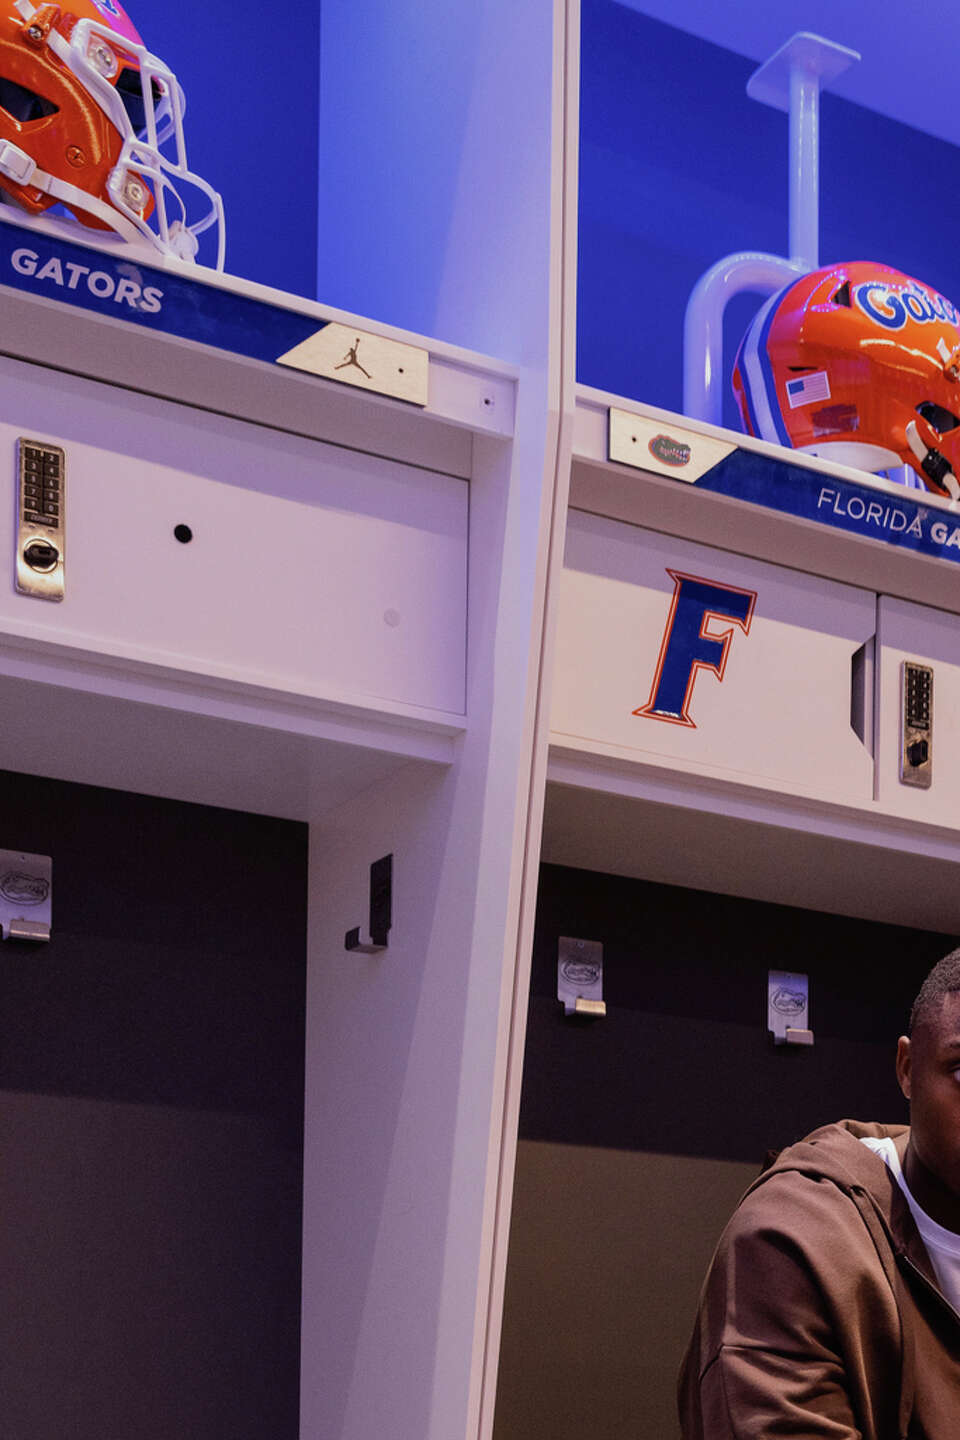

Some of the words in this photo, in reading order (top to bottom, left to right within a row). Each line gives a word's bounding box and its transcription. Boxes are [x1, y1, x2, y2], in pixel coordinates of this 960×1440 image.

[11, 248, 164, 313] GATORS
[817, 487, 923, 539] FLORIDA
[632, 567, 757, 729] F
